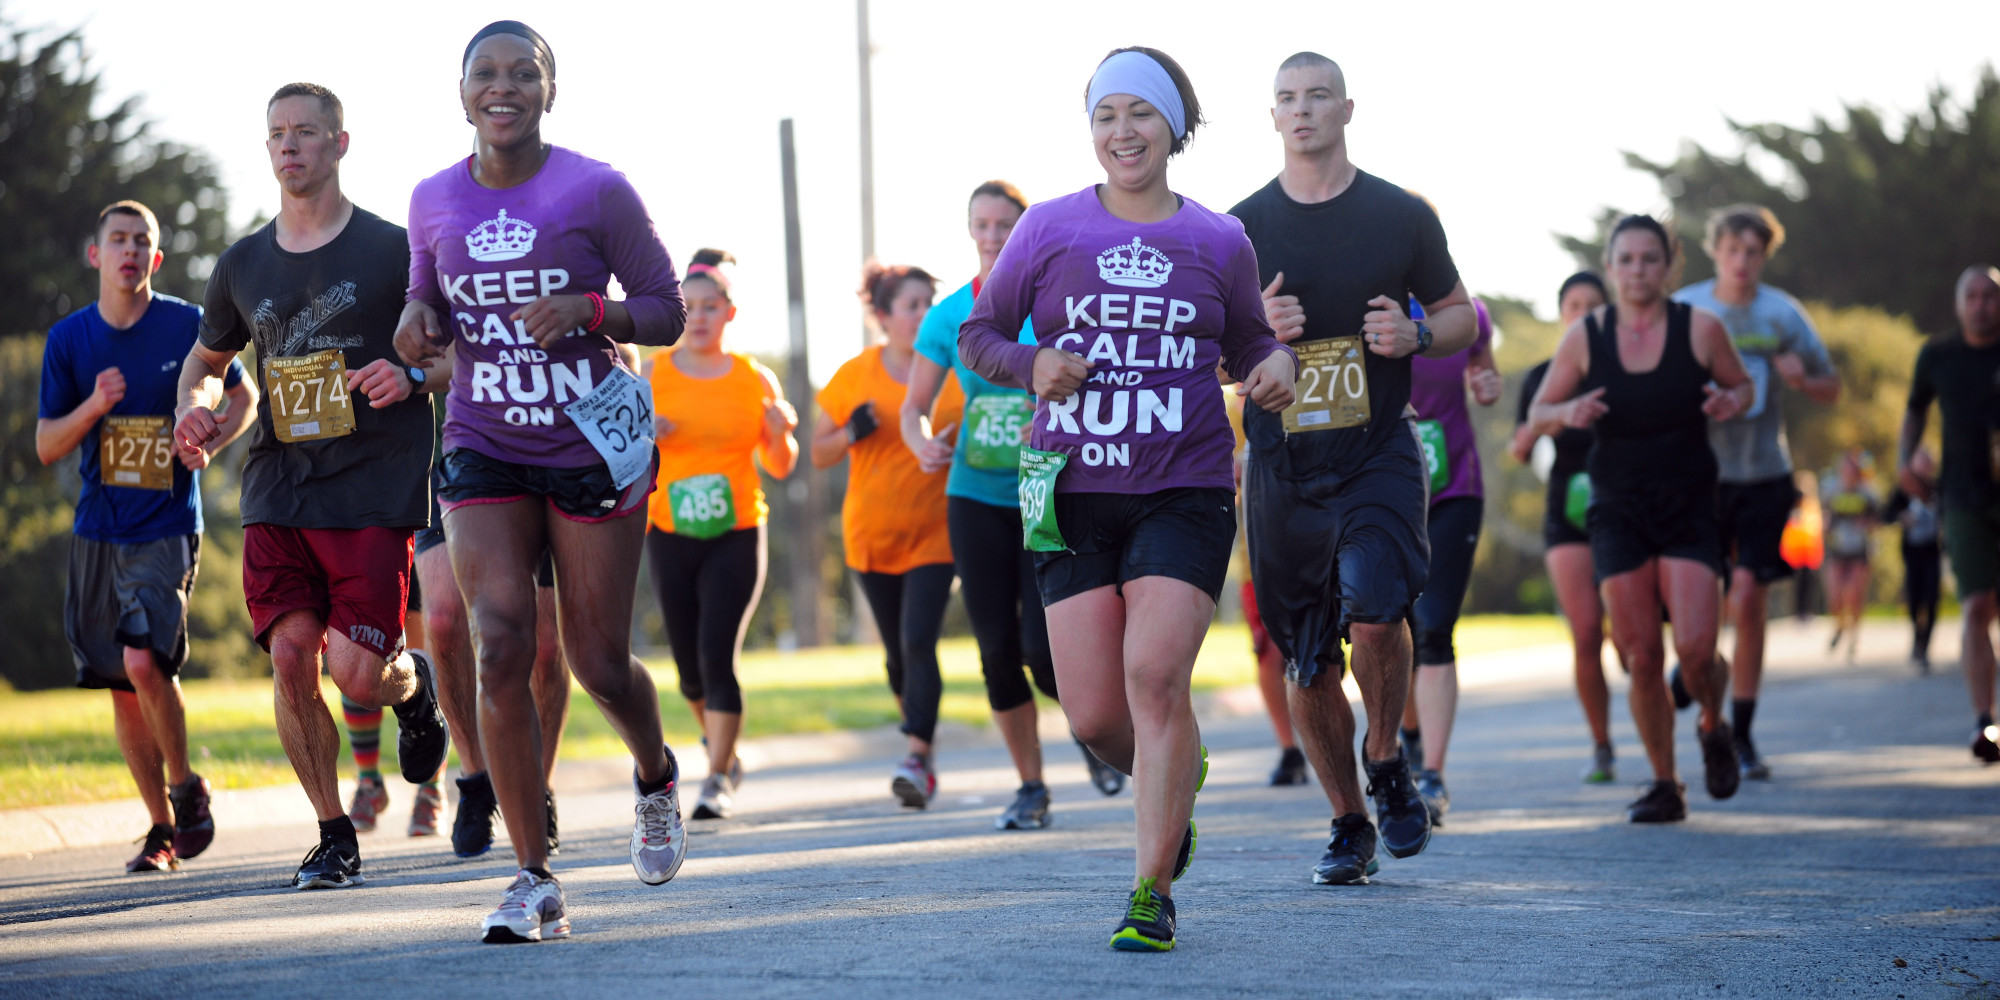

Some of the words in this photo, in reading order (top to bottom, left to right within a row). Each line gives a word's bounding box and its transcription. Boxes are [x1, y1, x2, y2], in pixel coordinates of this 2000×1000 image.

[443, 268, 570, 307] KEEP
[455, 312, 588, 346] CAL
[1065, 293, 1197, 333] KEEP
[272, 360, 292, 368] 2013
[293, 357, 312, 366] MUD
[313, 354, 333, 363] RUN
[498, 347, 548, 365] AND
[1308, 343, 1329, 352] MUD
[1331, 341, 1352, 349] RUN
[283, 363, 324, 374] INDIVIDUAL
[471, 358, 594, 403] RUN
[1088, 370, 1143, 386] AND
[1293, 362, 1364, 406] 270
[272, 373, 349, 417] 1274
[576, 395, 601, 412] 2013
[599, 378, 617, 395] MUD
[592, 380, 629, 412] INDIVIDUAL
[1046, 387, 1183, 436] RUN
[504, 406, 554, 426] ON
[596, 389, 651, 453] 524
[974, 415, 1022, 448] 455
[104, 436, 171, 469] 1275
[1081, 442, 1130, 467] ON
[678, 488, 729, 523] 485
[1018, 476, 1047, 521] 469
[350, 625, 387, 651] VMI
